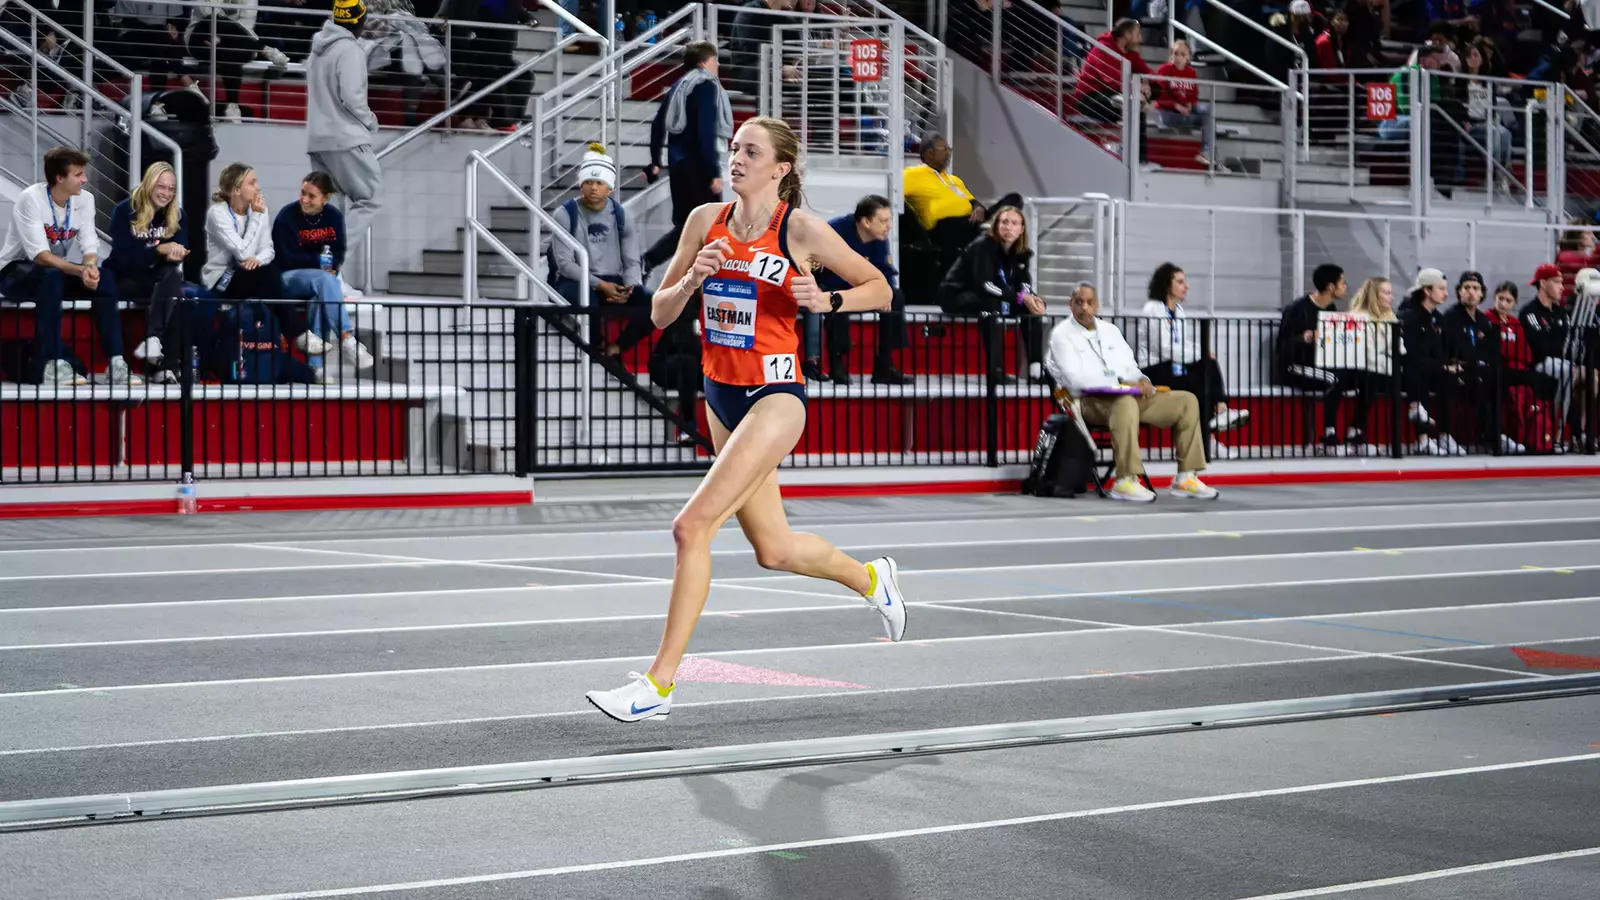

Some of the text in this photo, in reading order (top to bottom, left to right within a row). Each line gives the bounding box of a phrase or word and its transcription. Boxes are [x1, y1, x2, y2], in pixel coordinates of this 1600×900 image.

[856, 44, 878, 59] 105
[856, 61, 878, 76] 106
[1370, 87, 1393, 101] 106
[1370, 102, 1392, 116] 107
[759, 255, 785, 283] 12
[706, 306, 752, 326] EASTMAN
[770, 356, 793, 380] 12
